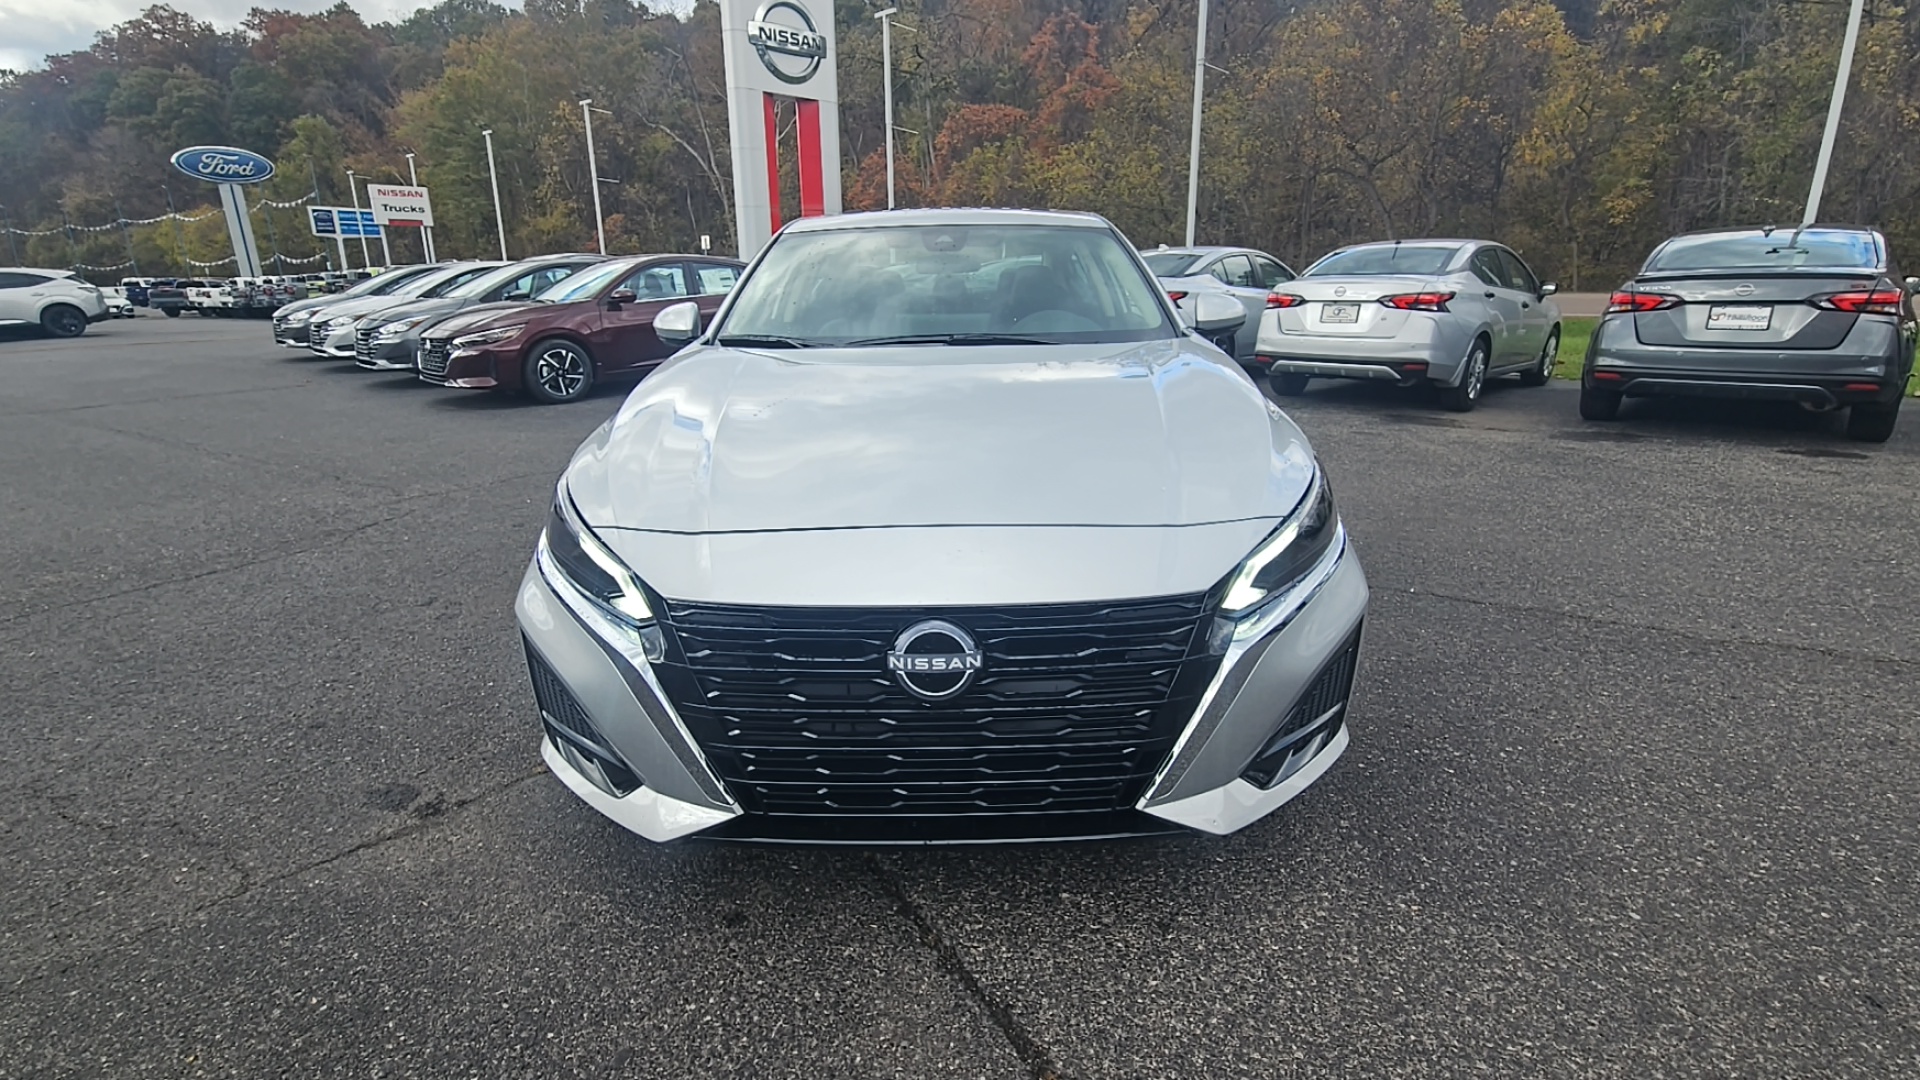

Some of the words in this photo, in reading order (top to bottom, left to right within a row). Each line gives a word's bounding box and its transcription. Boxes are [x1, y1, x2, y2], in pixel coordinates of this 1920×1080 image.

[758, 26, 821, 51] NISSAN
[198, 152, 255, 176] Ford
[377, 188, 424, 198] NISSAN
[381, 203, 425, 214] Trucks
[889, 654, 981, 670] NISSAN
